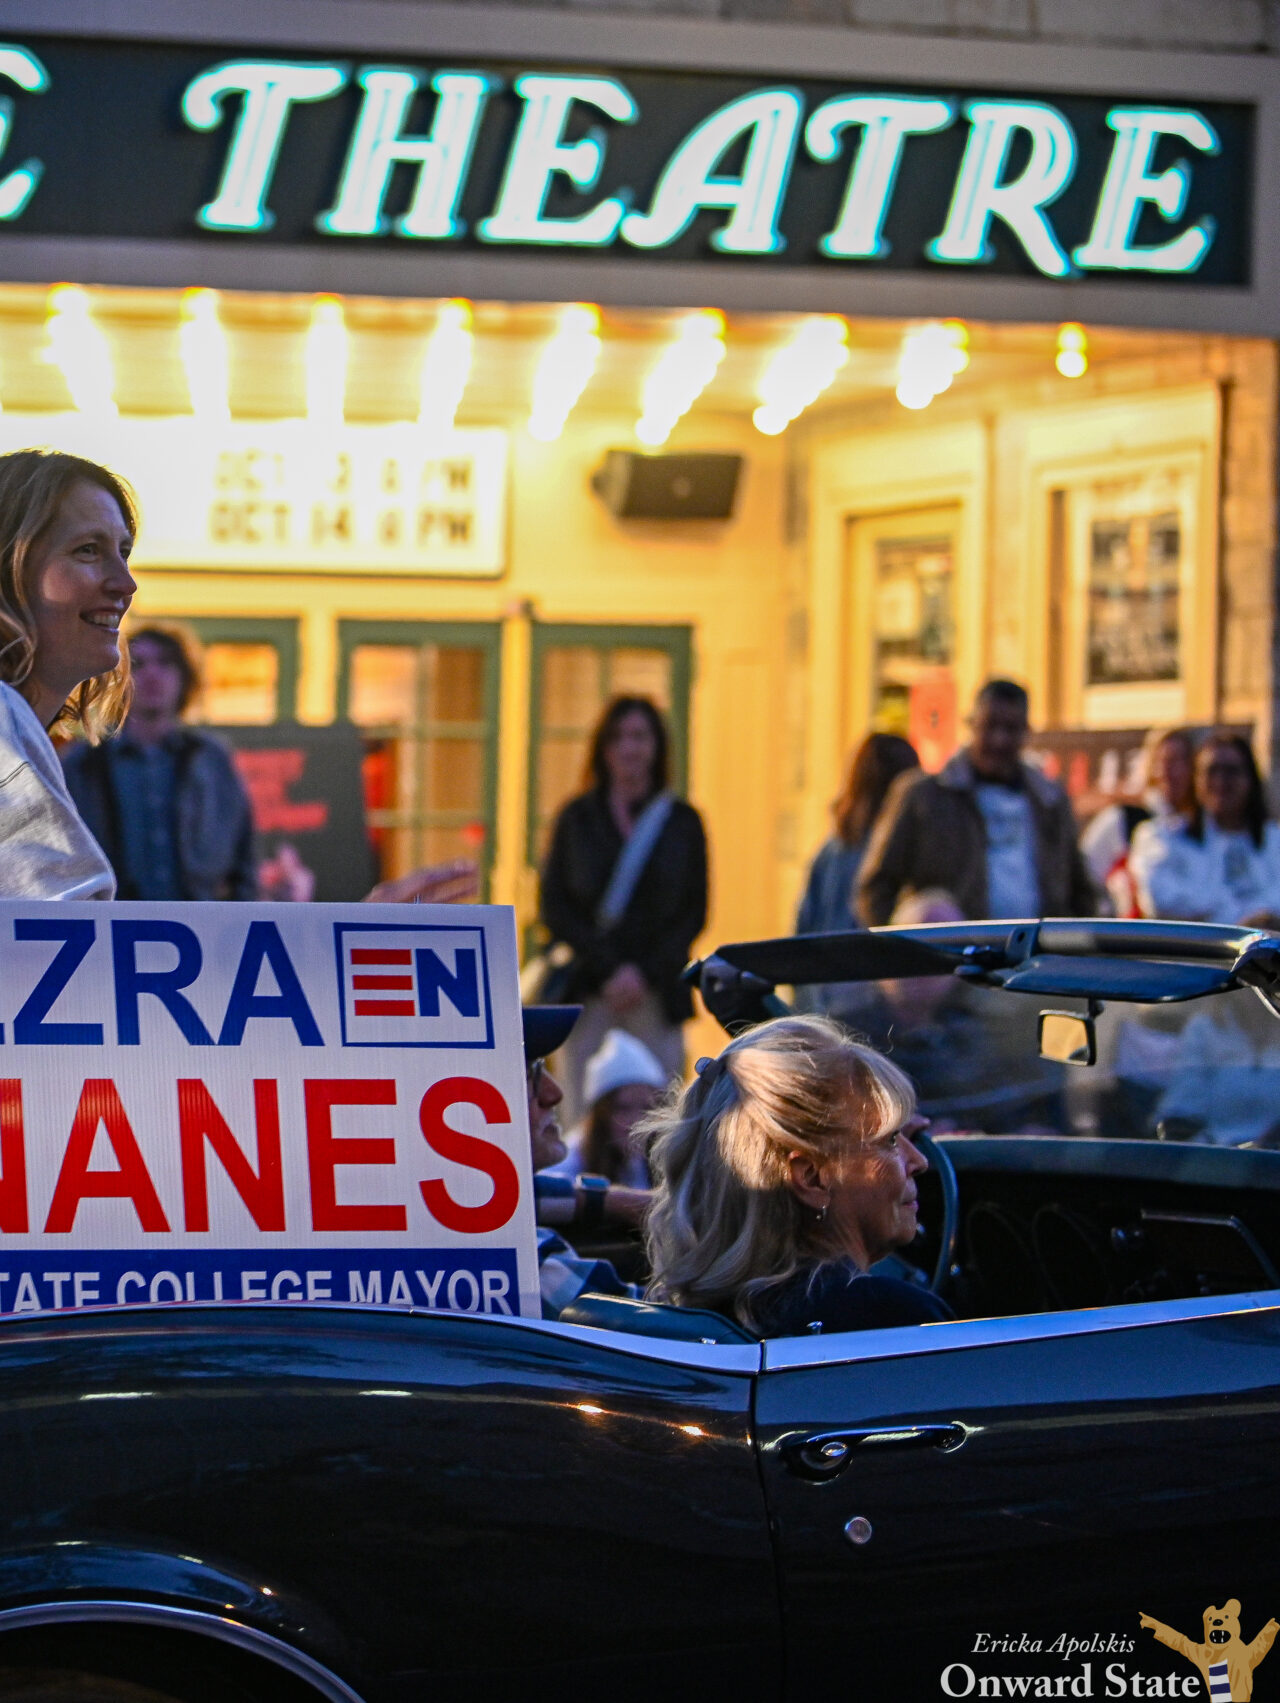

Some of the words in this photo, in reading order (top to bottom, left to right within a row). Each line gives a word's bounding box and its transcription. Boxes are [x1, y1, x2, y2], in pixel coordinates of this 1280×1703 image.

[182, 59, 1219, 279] THEATRE
[209, 499, 292, 546] OCT
[417, 503, 476, 550] PM
[350, 948, 480, 1018] EN
[116, 1270, 333, 1305] COLLEGE
[349, 1269, 514, 1316] MAYOR
